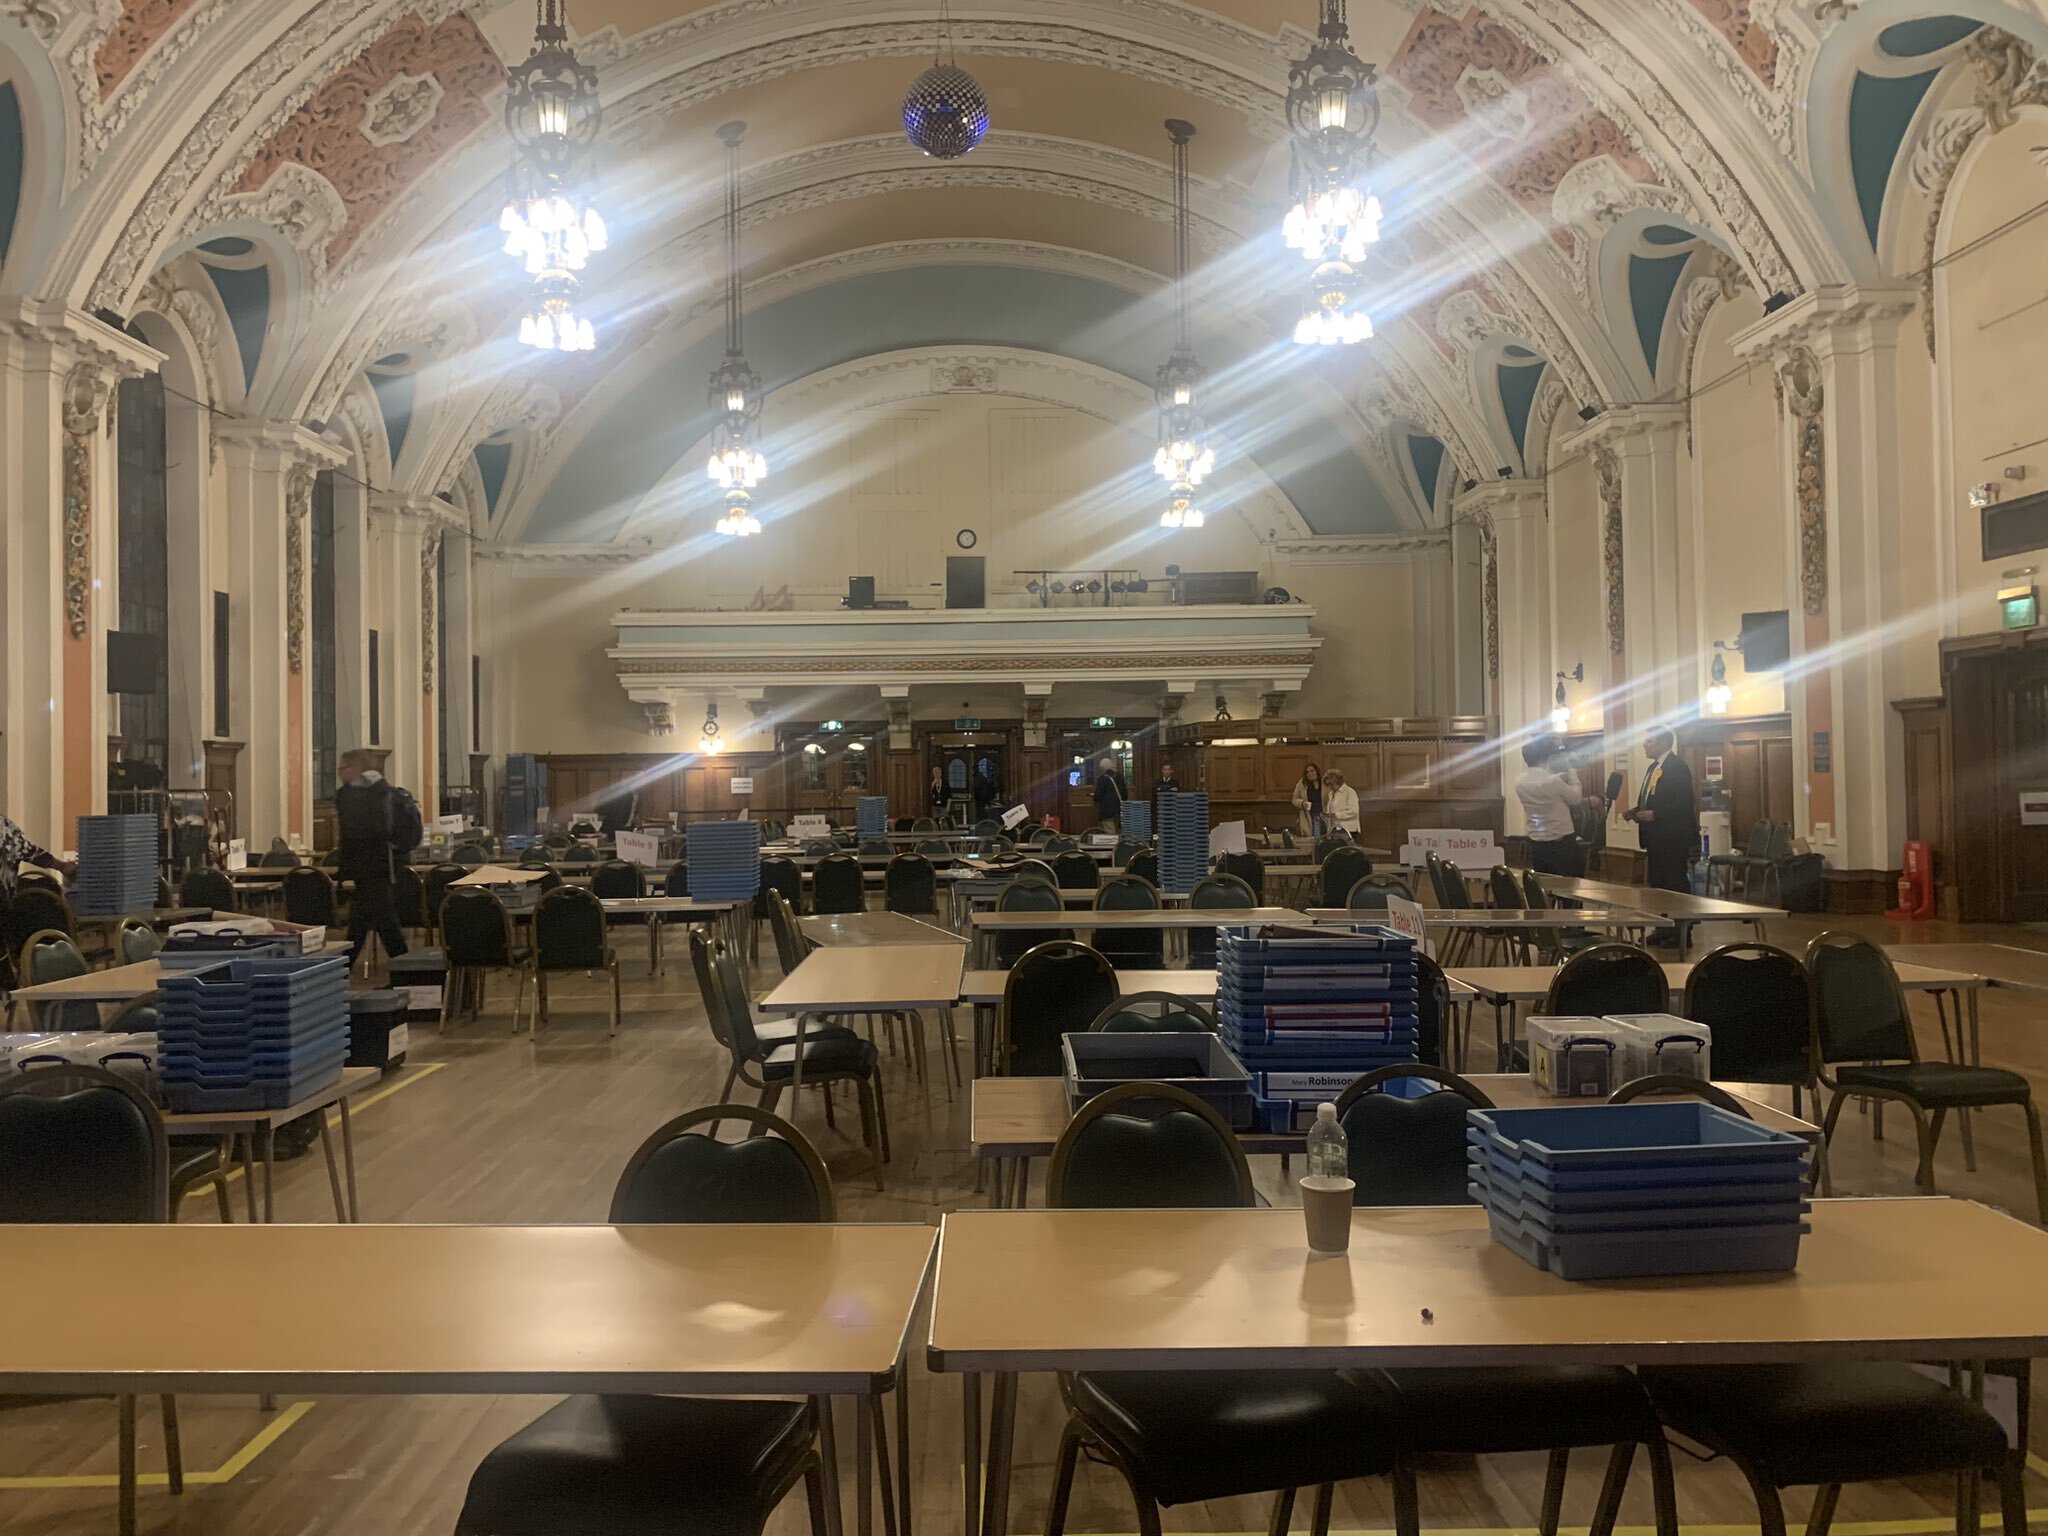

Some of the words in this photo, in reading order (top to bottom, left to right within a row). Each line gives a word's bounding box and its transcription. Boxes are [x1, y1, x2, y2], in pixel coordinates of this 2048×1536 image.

[622, 836, 645, 849] Table
[1446, 838, 1478, 849] Table
[1480, 837, 1488, 848] 9
[1391, 910, 1412, 933] Table
[1411, 915, 1422, 936] 11
[1539, 1057, 1546, 1074] A
[1291, 1079, 1308, 1087] Mary
[1308, 1076, 1354, 1086] Robinson
